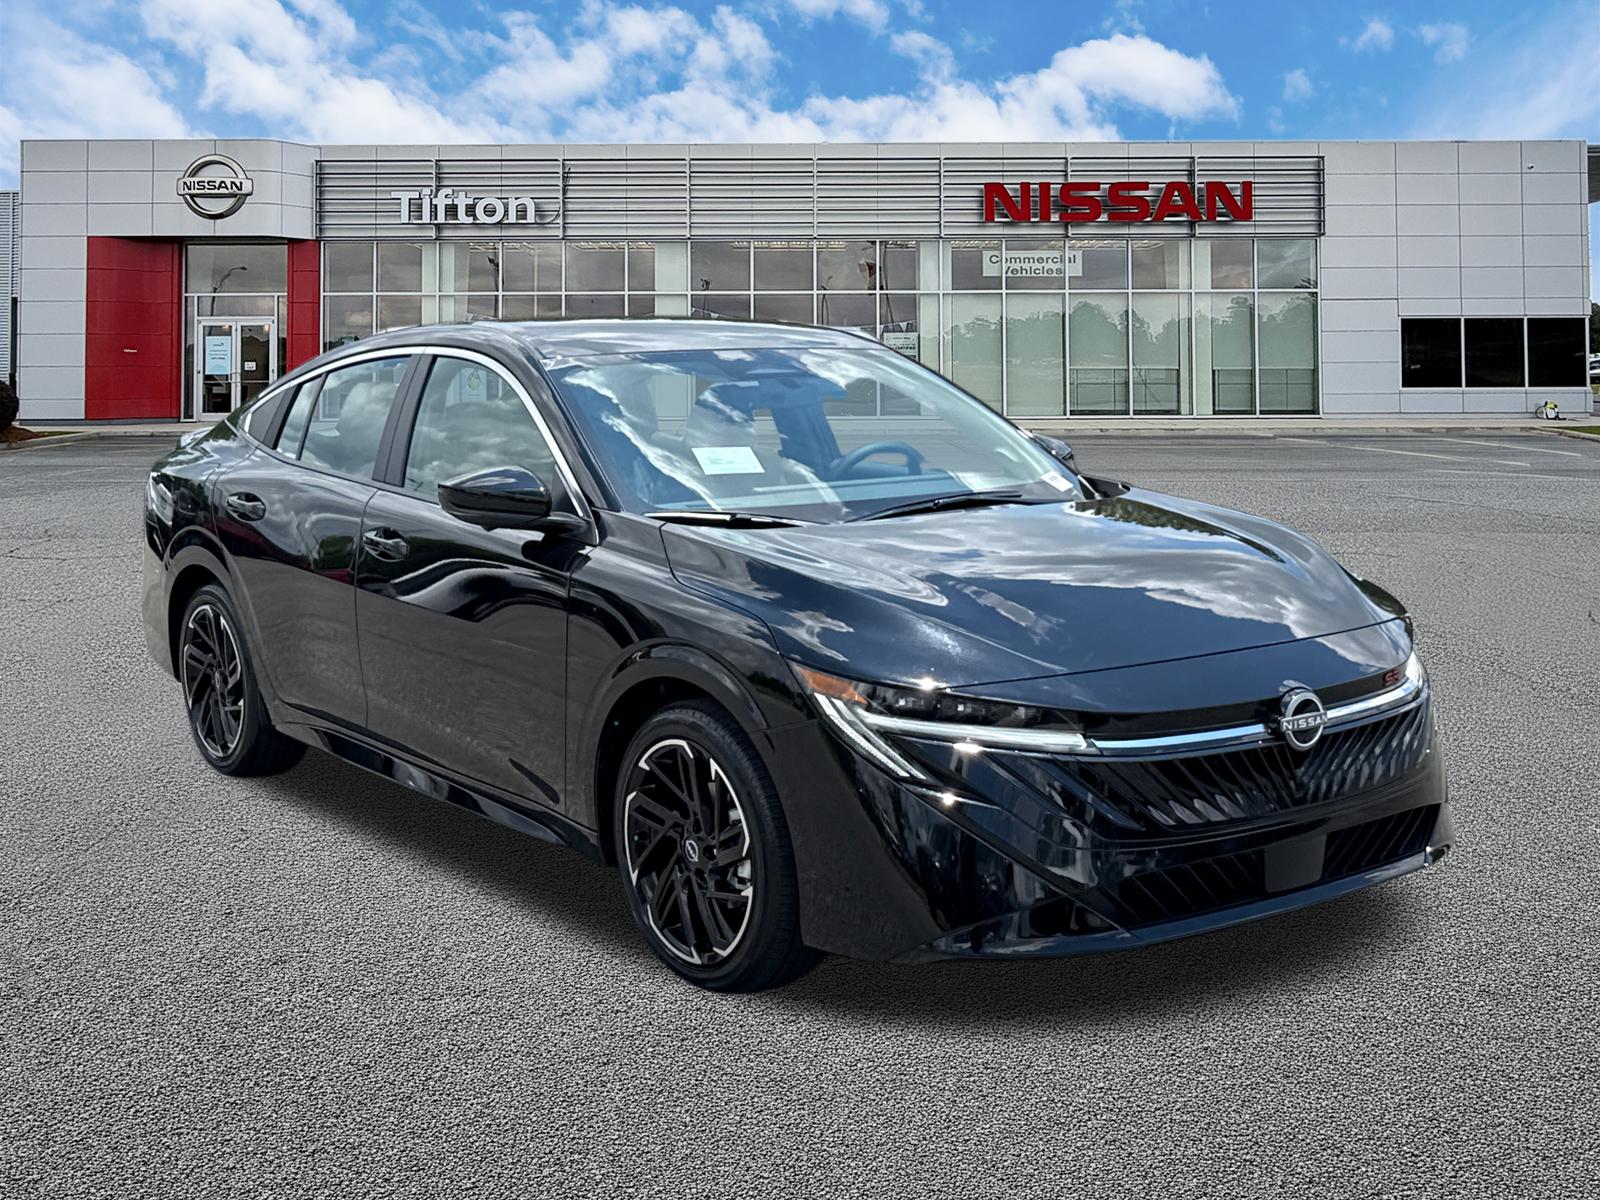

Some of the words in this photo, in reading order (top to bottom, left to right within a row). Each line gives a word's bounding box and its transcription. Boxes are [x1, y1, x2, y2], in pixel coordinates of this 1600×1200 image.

[182, 180, 243, 191] NISSAN
[391, 188, 536, 224] Tifton
[983, 181, 1253, 222] NISSAN
[1282, 714, 1328, 731] NISSAN
